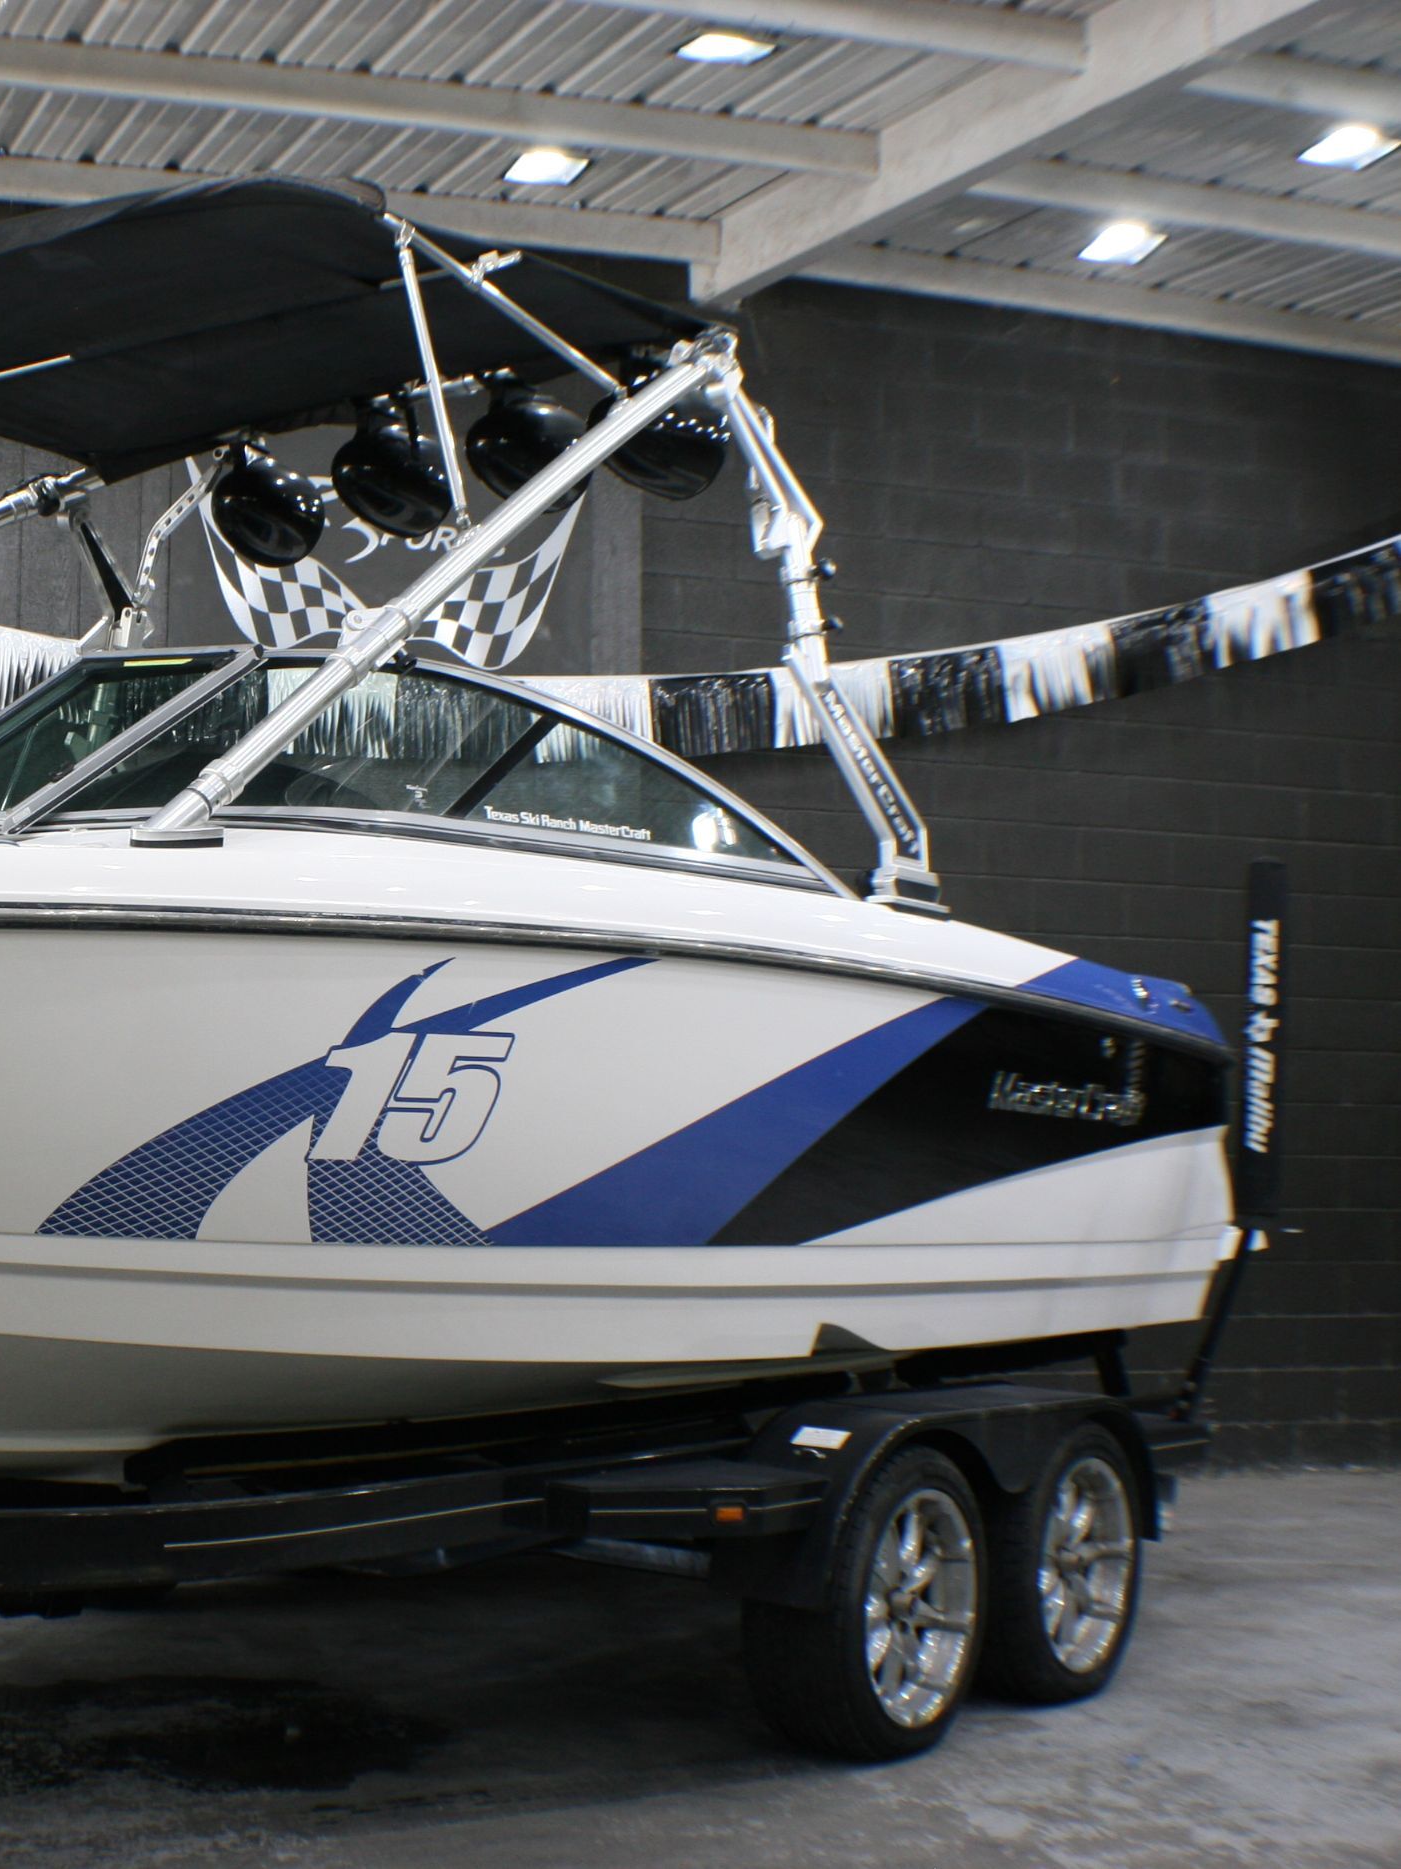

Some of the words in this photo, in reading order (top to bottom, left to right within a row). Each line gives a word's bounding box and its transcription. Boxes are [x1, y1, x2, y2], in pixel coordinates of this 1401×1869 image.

[484, 805, 519, 822] Texas
[520, 812, 540, 826] Ski
[542, 815, 577, 831] Ranch
[579, 820, 651, 841] MasterCraft
[1249, 918, 1280, 1004] TEXAS
[306, 1028, 516, 1166] 15
[1244, 1046, 1276, 1153] Malibu
